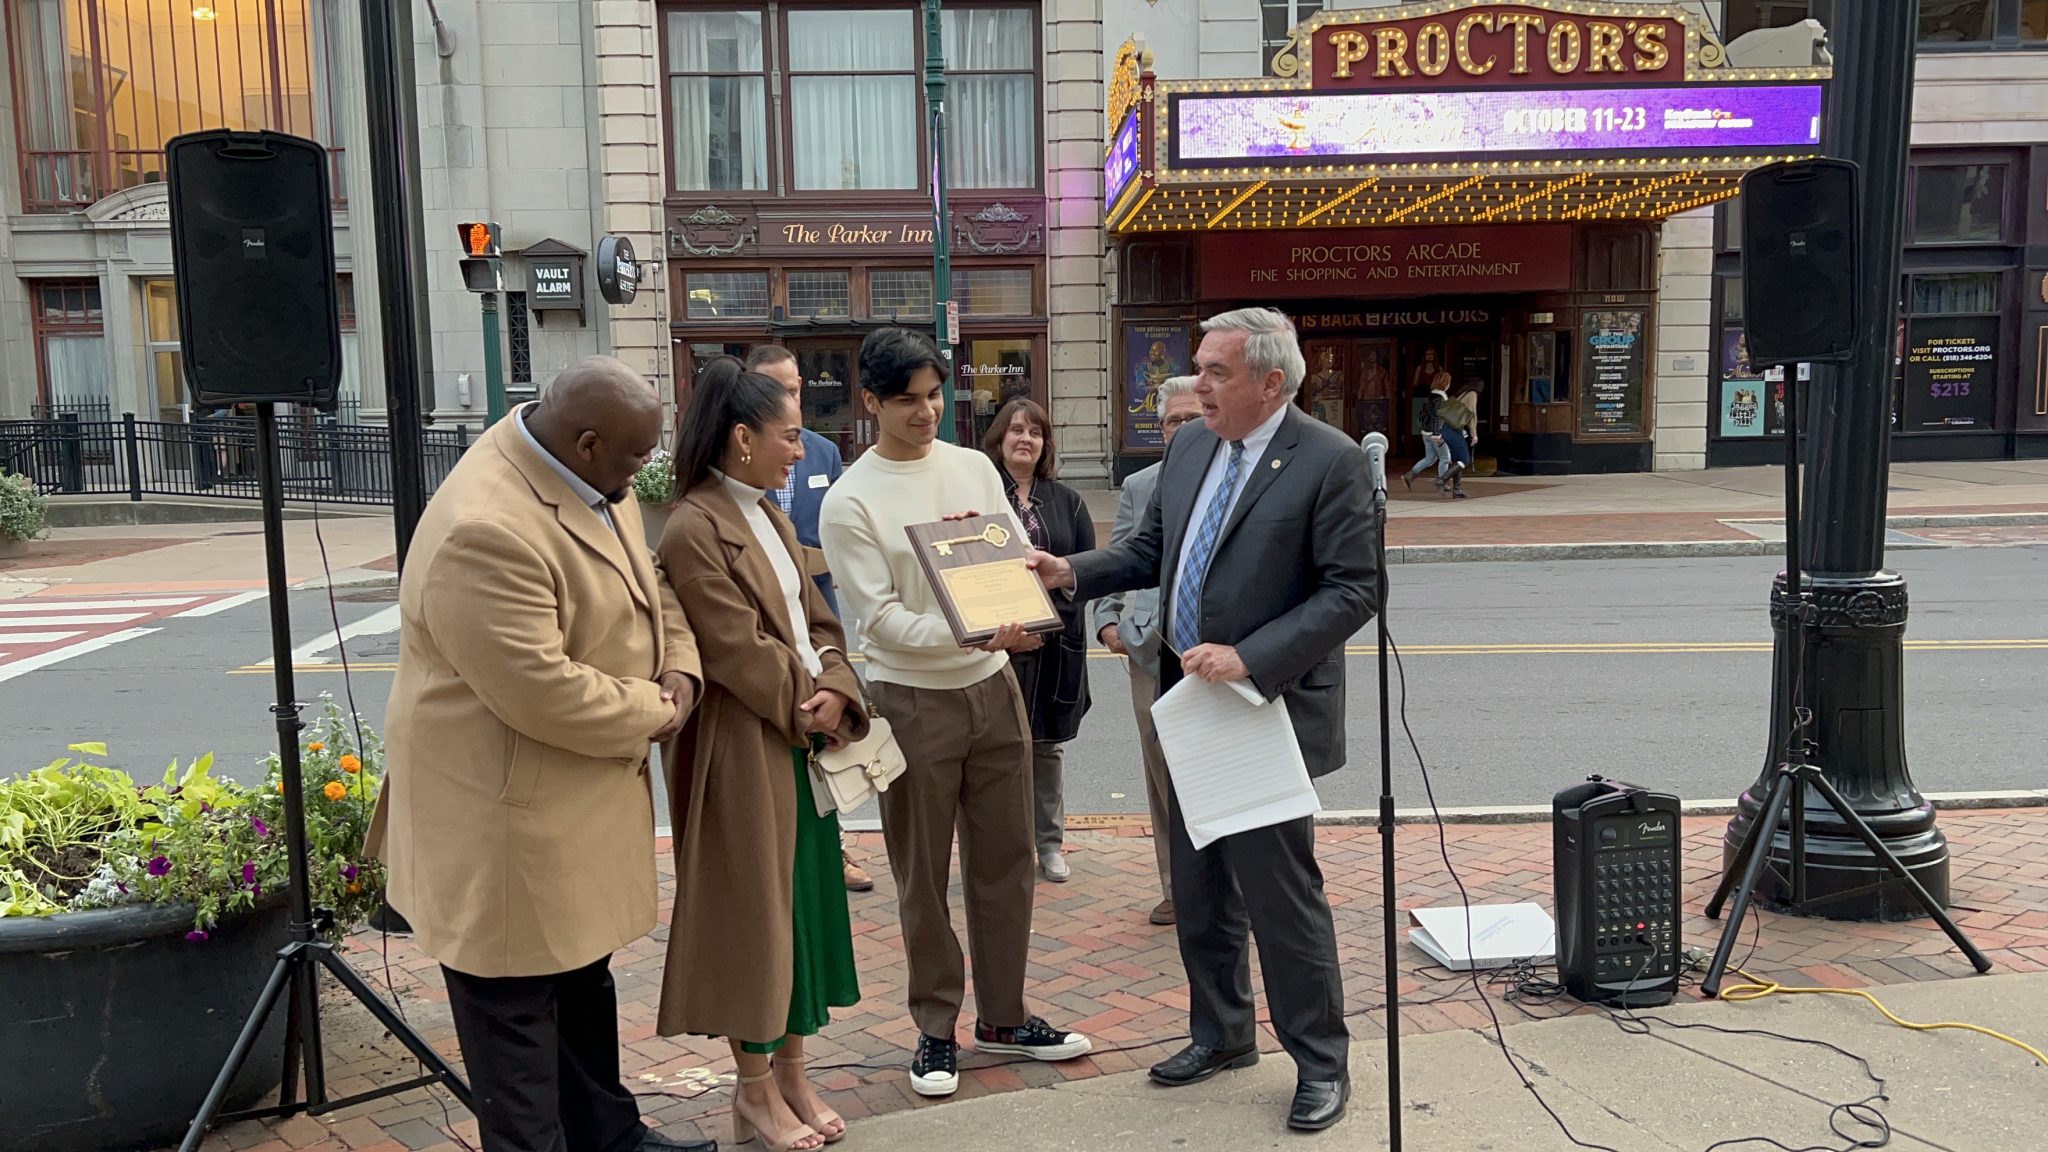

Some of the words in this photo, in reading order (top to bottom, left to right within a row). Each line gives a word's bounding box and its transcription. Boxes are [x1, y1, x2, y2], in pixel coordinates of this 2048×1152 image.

[1329, 11, 1669, 79] PROCTOR'S
[1503, 107, 1586, 133] OCTOBER
[1592, 106, 1646, 133] 11-23
[782, 223, 820, 243] The
[828, 222, 892, 243] Parker
[898, 223, 934, 243] Inn
[1291, 245, 1392, 264] PROCTORS
[1405, 243, 1482, 261] ARCADE
[535, 268, 570, 279] VAULT
[1250, 269, 1279, 283] FINE
[1286, 267, 1357, 282] SHOPPING
[1367, 266, 1399, 280] AND
[1408, 262, 1522, 278] ENTERTAINMENT
[536, 282, 571, 293] ALARM
[1321, 313, 1362, 327] BACK
[1589, 335, 1635, 345] GROUP
[960, 364, 977, 374] The
[980, 363, 1008, 374] Parker
[1008, 364, 1024, 373] Inn
[1930, 382, 1970, 399] $213
